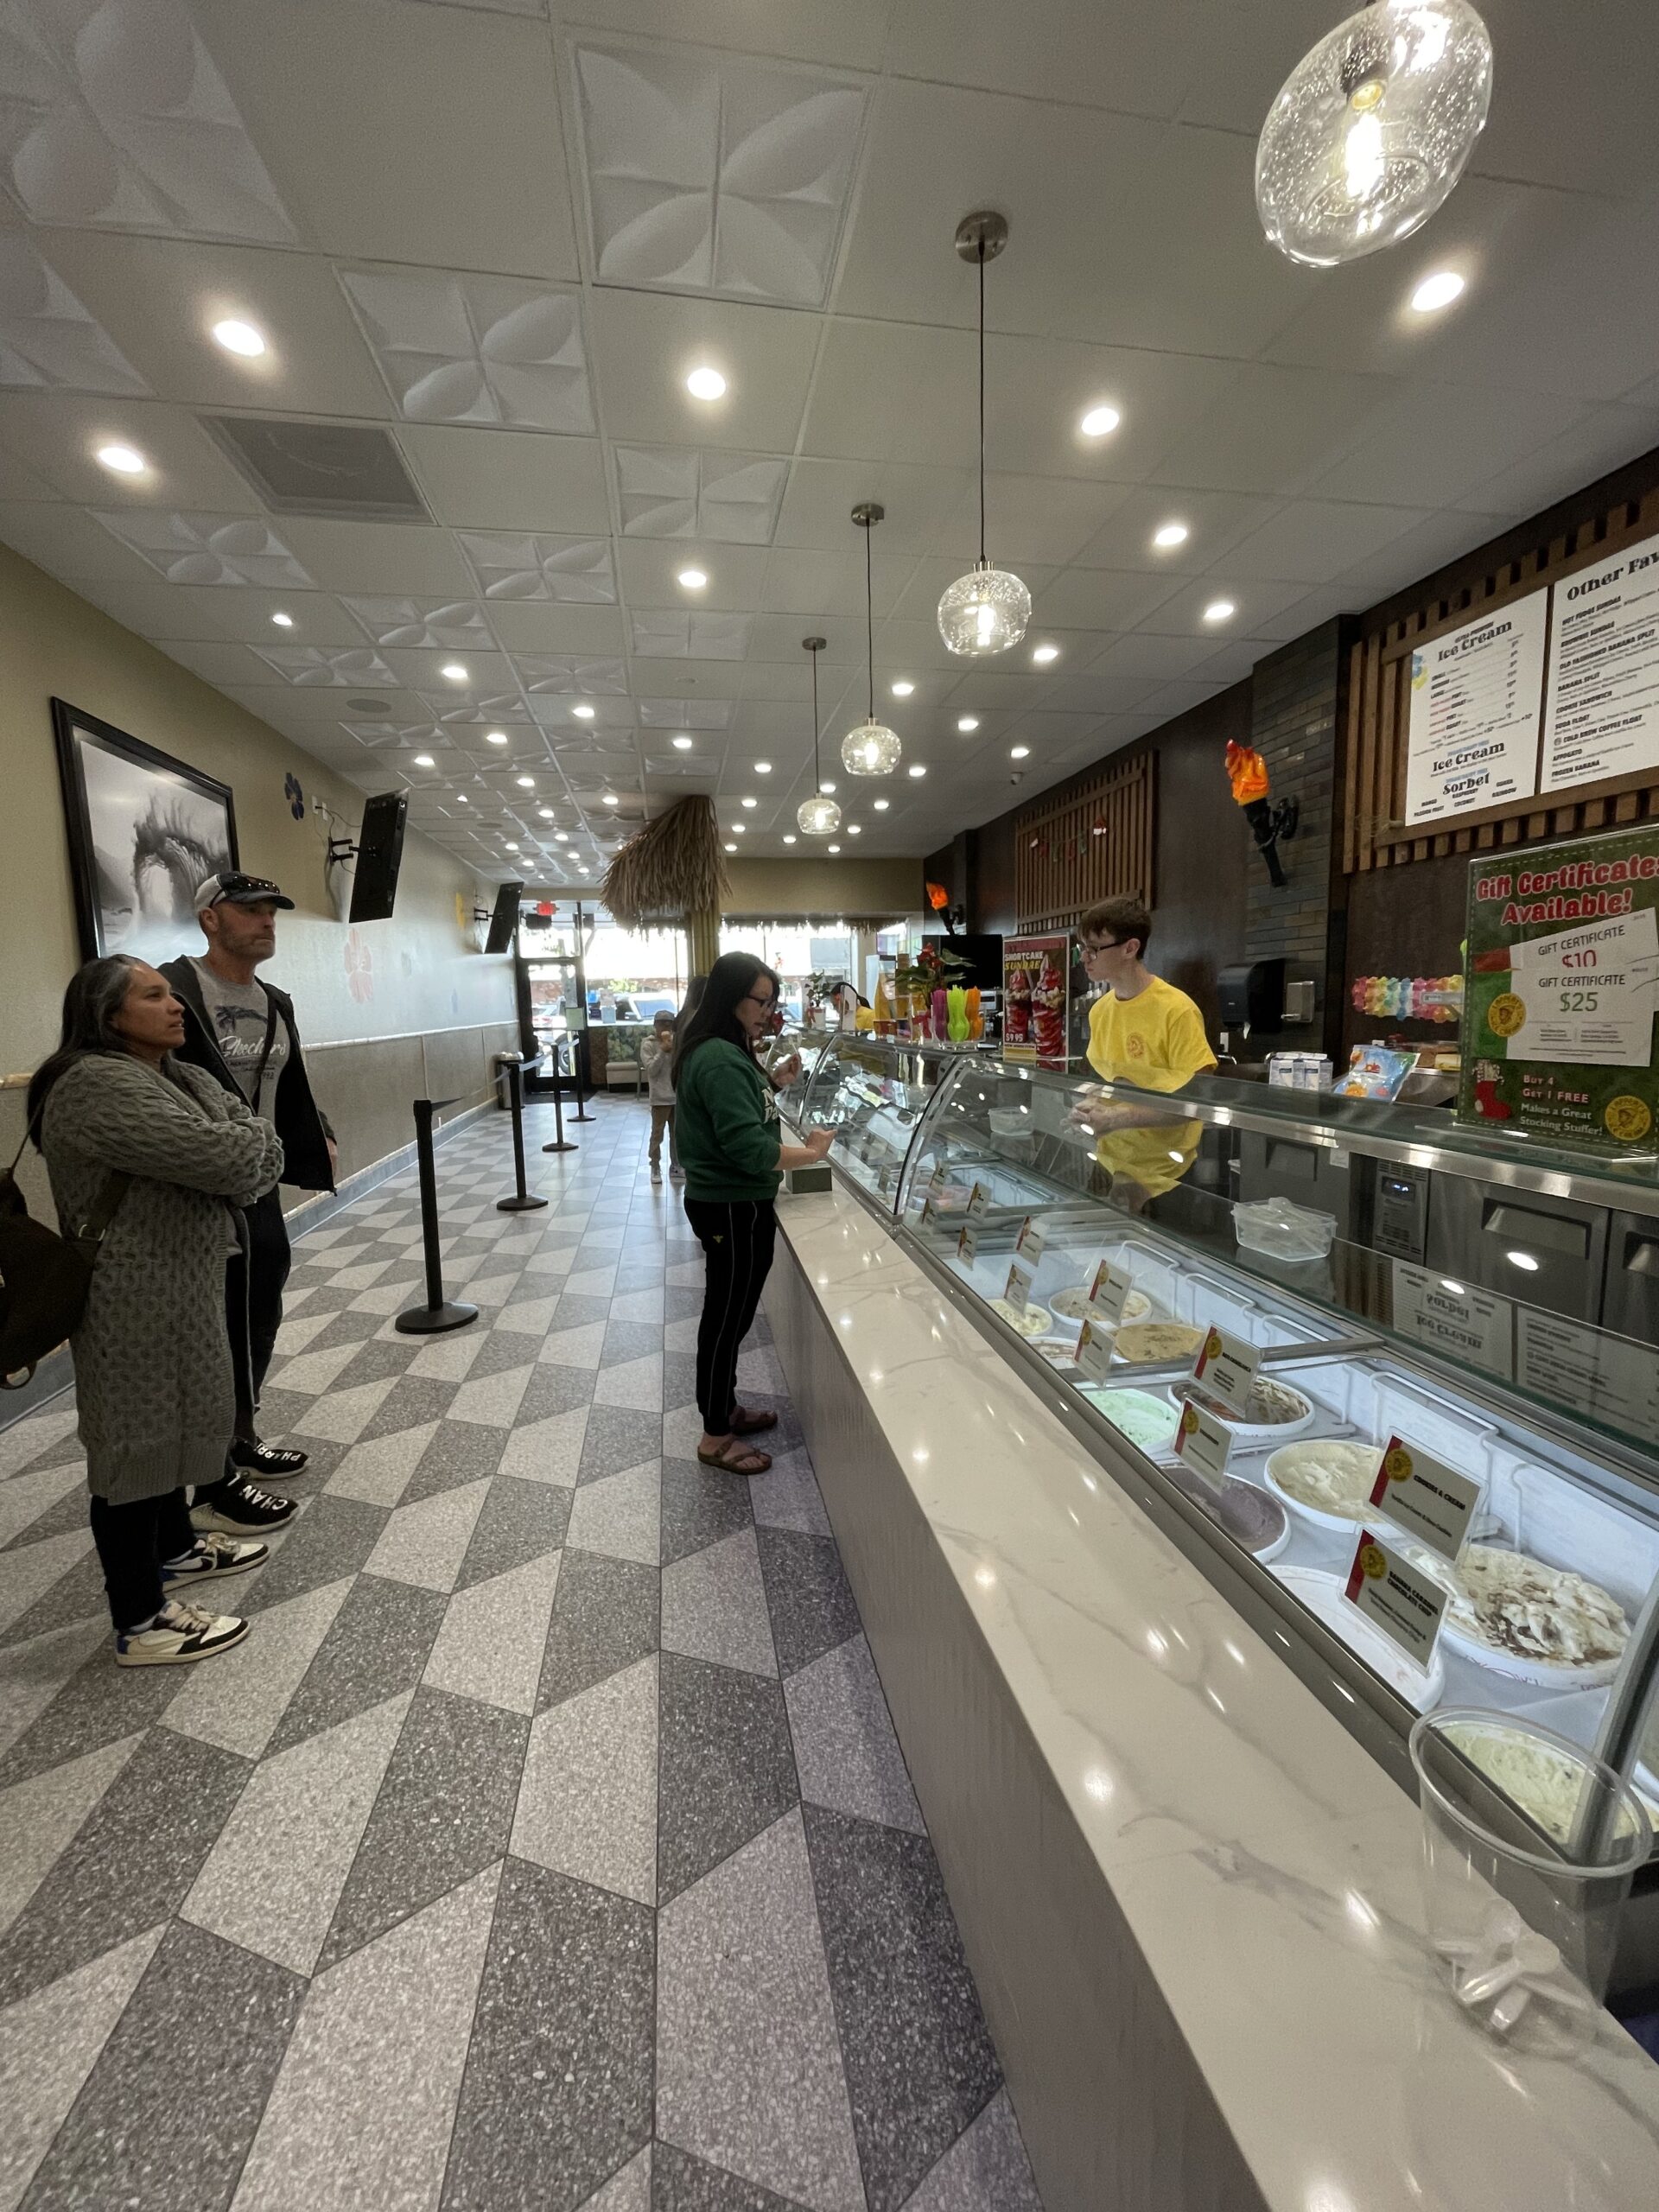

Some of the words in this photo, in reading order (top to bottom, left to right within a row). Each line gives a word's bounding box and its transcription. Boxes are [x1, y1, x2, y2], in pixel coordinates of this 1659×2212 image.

[1567, 568, 1624, 601] Other
[1438, 645, 1459, 663] Ice
[1461, 621, 1513, 652] Cream
[1599, 721, 1622, 733] COFFEE
[1622, 714, 1643, 727] FLOAT
[1433, 758, 1453, 772] Ice
[1455, 742, 1505, 766] Cream
[1442, 772, 1491, 795] Sorbet
[1477, 874, 1512, 902] Gift
[1518, 854, 1659, 895] Certificate
[1501, 887, 1633, 926] Available!
[1538, 943, 1558, 956] GIFT
[1560, 925, 1626, 950] CERTIFICATE
[1004, 950, 1044, 962] SHORTCAKE
[1561, 950, 1598, 968] $10
[1538, 977, 1558, 988] GIFT
[1561, 974, 1626, 987] CERTIFICATE
[1560, 991, 1599, 1013] $25
[219, 1035, 287, 1058] Skechrs
[1547, 1076, 1554, 1085] 4
[1557, 1090, 1591, 1103] FREE
[1521, 1103, 1551, 1116] Makes
[1561, 1107, 1592, 1120] Great
[1520, 1116, 1561, 1132] Stocking
[1564, 1122, 1604, 1136] Stuffer!
[227, 1471, 289, 1510] CHANL
[1443, 1493, 1466, 1511] CREAM
